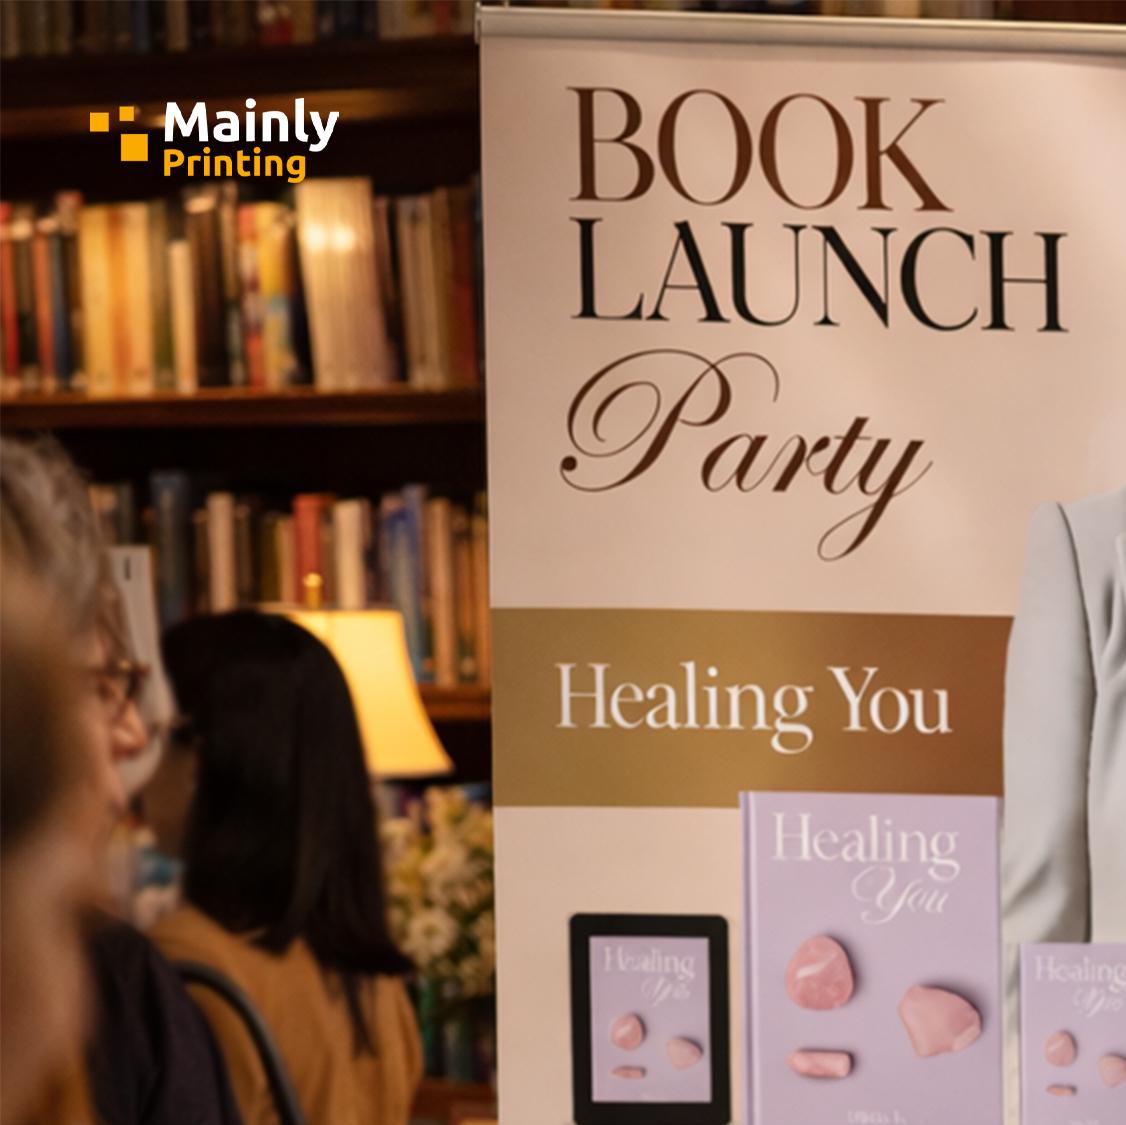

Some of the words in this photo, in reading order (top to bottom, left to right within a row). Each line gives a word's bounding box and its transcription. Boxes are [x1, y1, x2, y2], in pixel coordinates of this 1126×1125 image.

[566, 86, 954, 213] BOOK
[569, 216, 1068, 333] LAUNCH
[560, 348, 933, 562] Party
[556, 661, 814, 754] Healing
[828, 667, 953, 735] You
[772, 811, 961, 882] Healing
[850, 864, 950, 925] You
